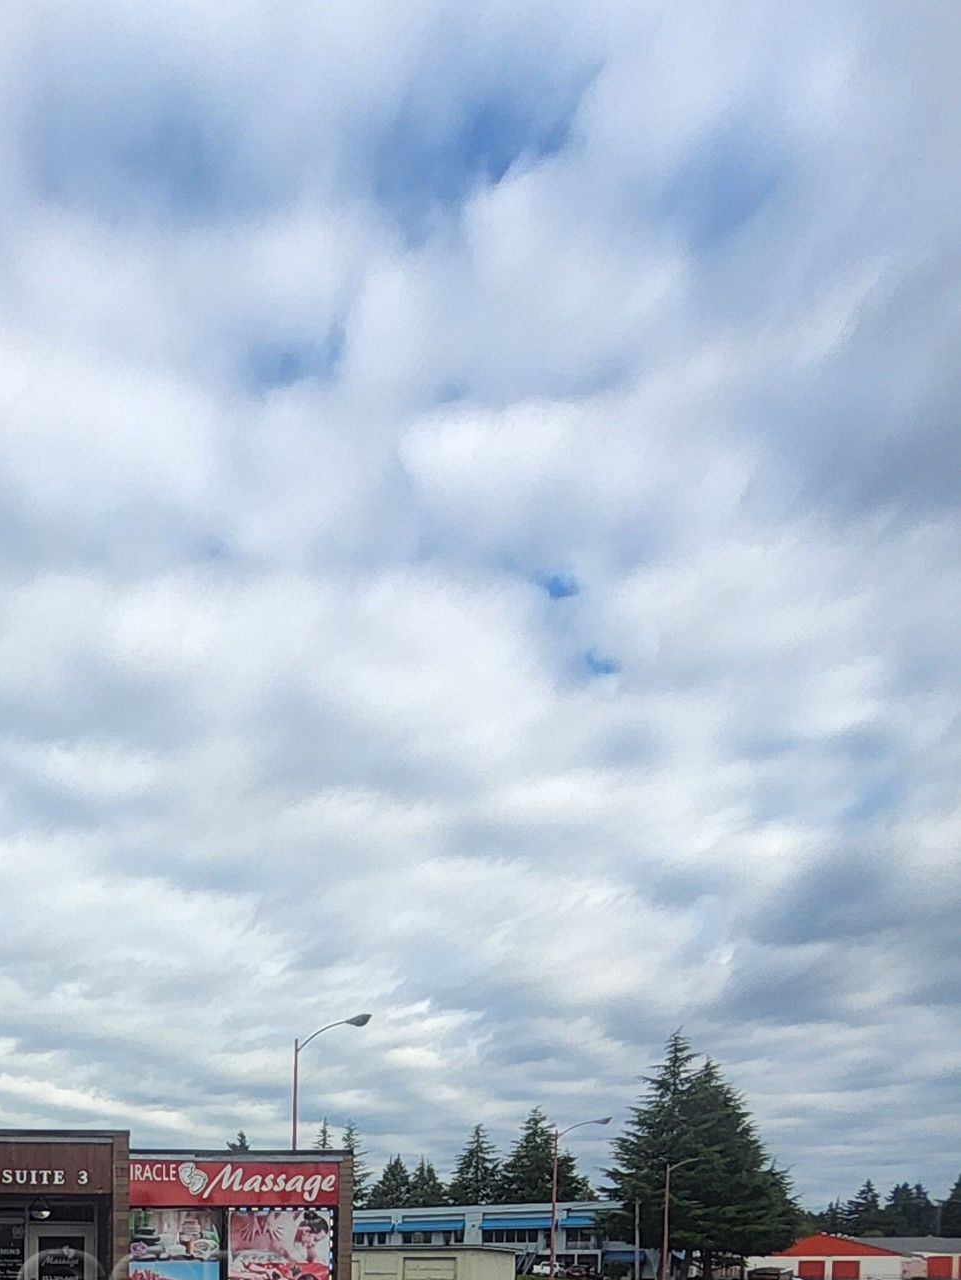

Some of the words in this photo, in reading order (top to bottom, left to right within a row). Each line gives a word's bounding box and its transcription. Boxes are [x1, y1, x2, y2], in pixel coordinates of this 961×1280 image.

[1, 1169, 65, 1185] SUITE
[77, 1169, 88, 1184] 3
[129, 1163, 177, 1181] IRACLE
[202, 1163, 336, 1200] Massage
